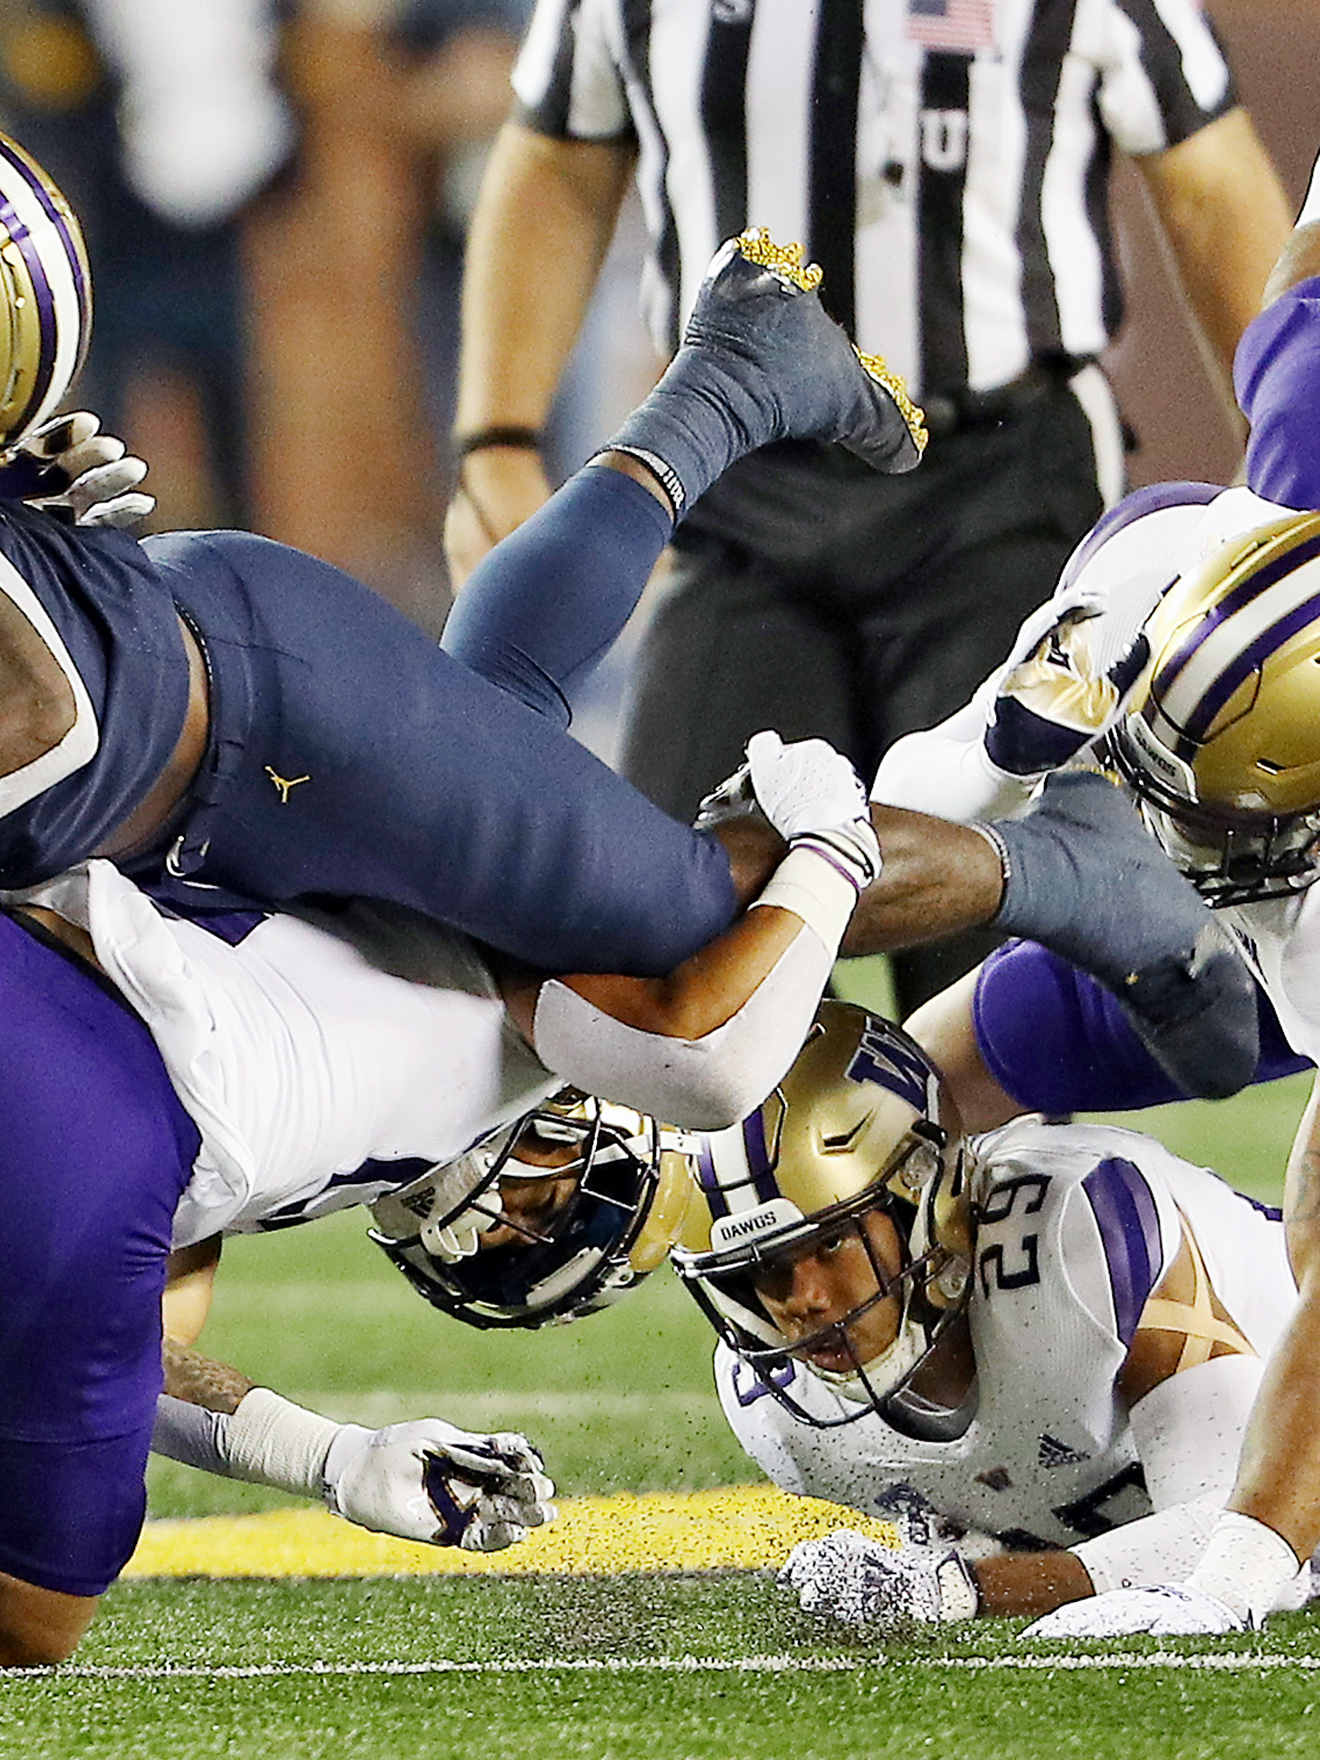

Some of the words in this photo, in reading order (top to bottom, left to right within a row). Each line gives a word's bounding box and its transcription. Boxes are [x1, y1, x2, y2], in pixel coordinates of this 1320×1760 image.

[919, 108, 968, 170] U
[720, 1210, 777, 1241] DAWGS
[979, 1173, 1053, 1299] 29
